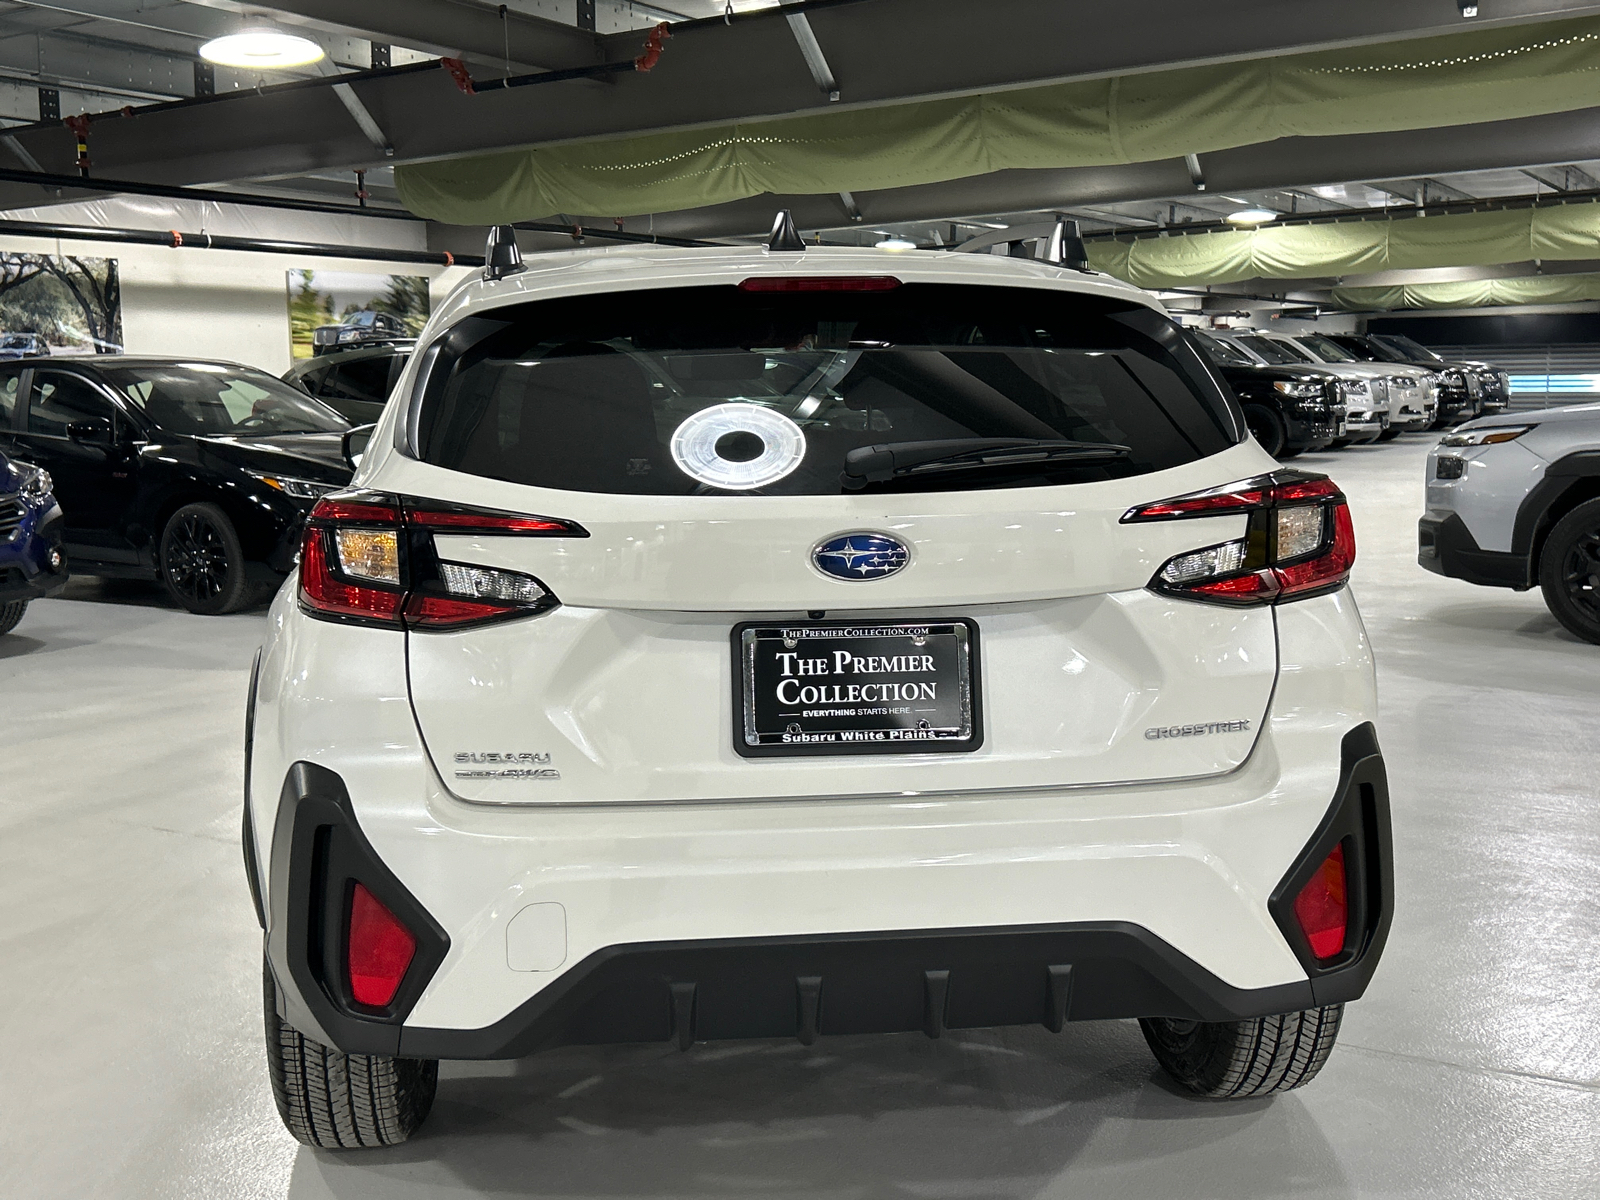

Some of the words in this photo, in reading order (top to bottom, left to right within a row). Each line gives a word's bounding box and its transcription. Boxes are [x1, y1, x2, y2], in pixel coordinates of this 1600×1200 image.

[775, 652, 829, 676] THE
[833, 650, 937, 674] PREMIER
[775, 679, 938, 706] COLLECTION
[802, 709, 856, 718] EVERYTHING
[857, 707, 888, 716] STARTS
[888, 706, 914, 715] HERE.
[782, 732, 836, 743] Subaru
[840, 731, 886, 742] White
[889, 729, 937, 740] Plains
[1144, 719, 1251, 740] CROSSTREK
[453, 752, 551, 764] SUBARU
